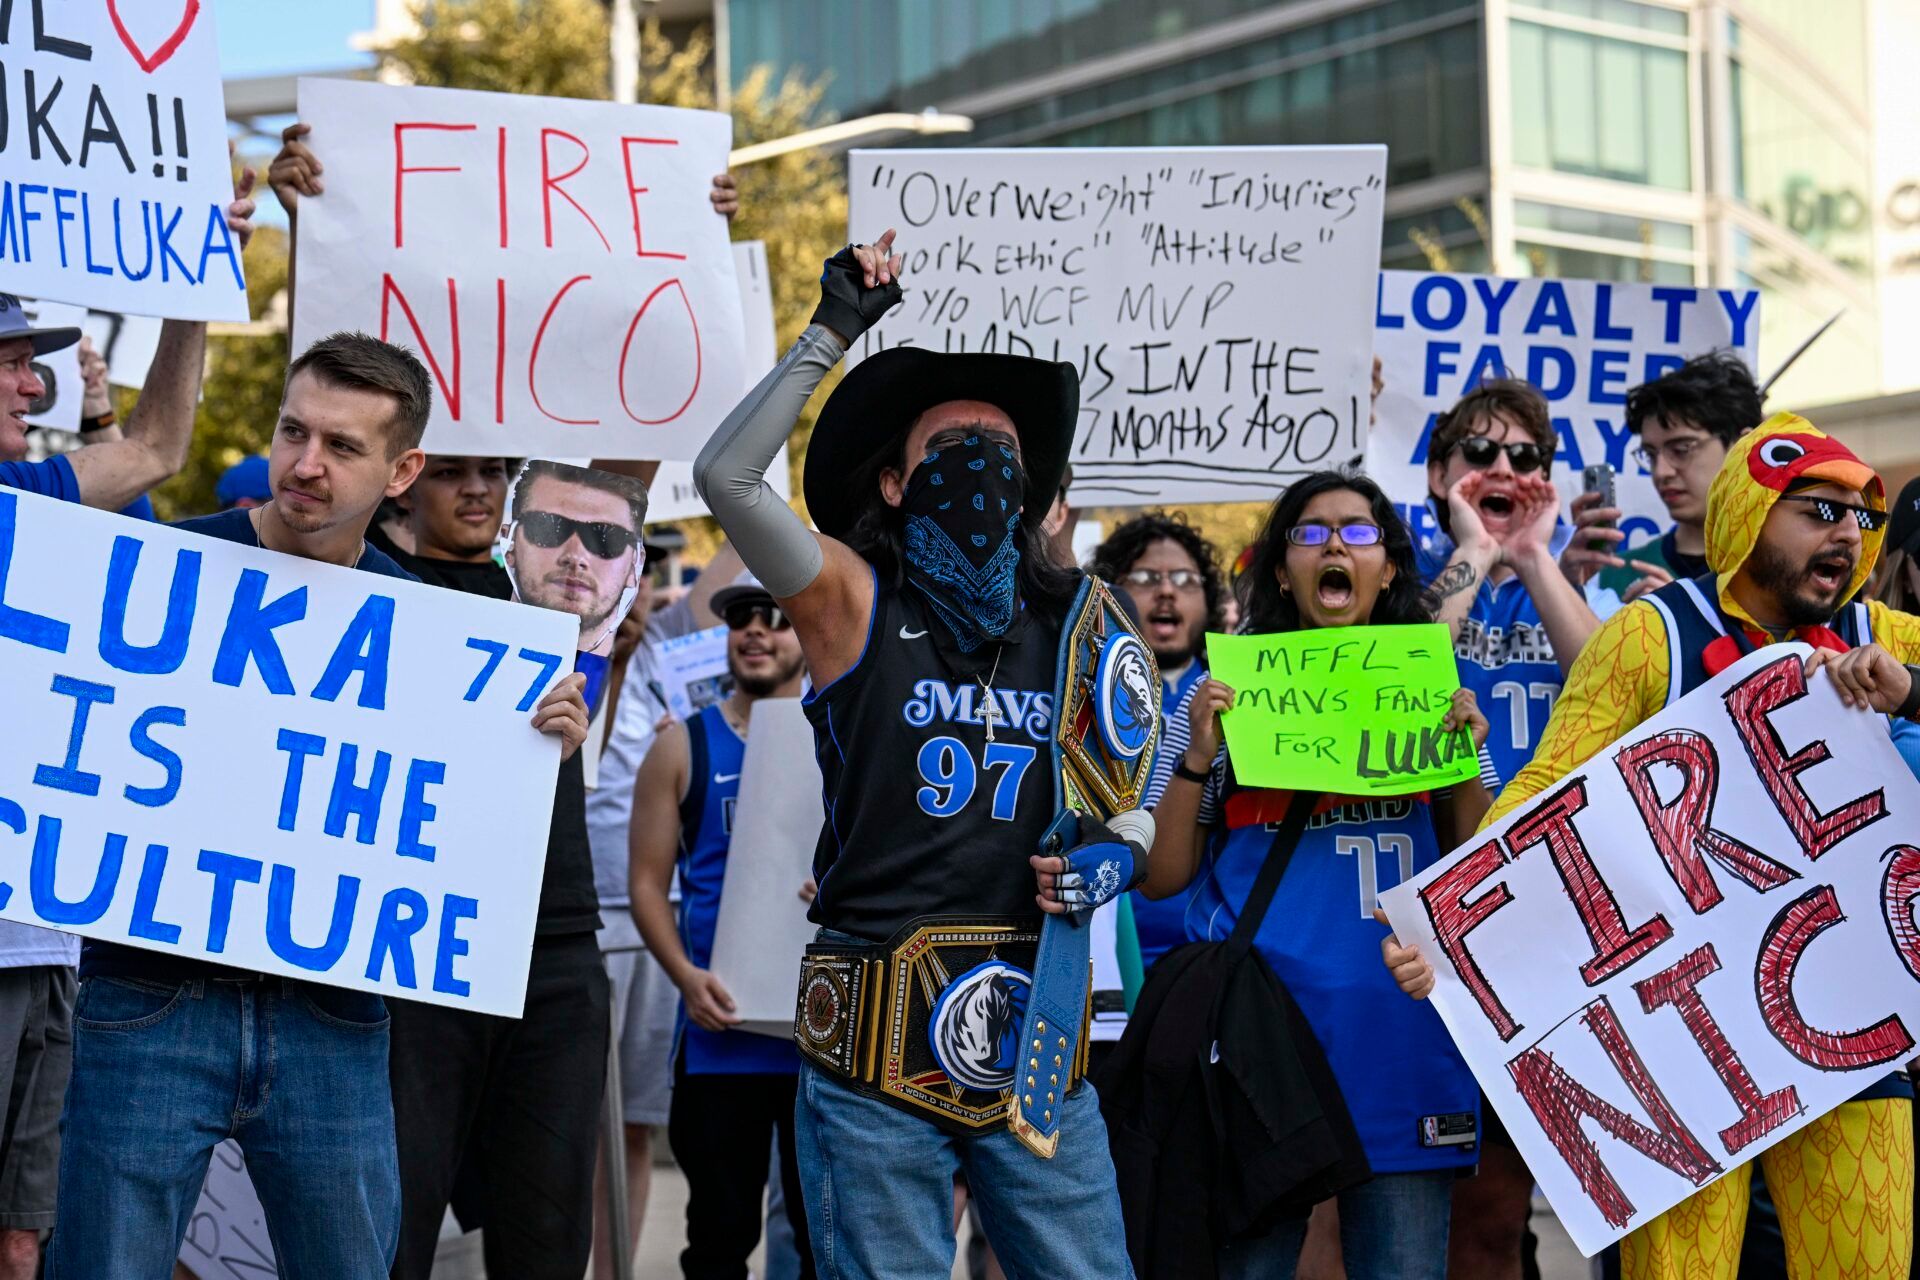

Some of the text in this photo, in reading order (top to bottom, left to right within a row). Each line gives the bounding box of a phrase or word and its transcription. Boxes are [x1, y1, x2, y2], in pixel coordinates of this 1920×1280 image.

[0, 60, 189, 182] KA!!
[394, 121, 687, 258] FIRE
[1000, 284, 1090, 329] WCF
[1117, 280, 1235, 331] MVP
[1375, 272, 1760, 347] LOYALTY
[381, 272, 702, 426] NICO
[1126, 342, 1208, 396] IN
[1214, 337, 1324, 398] THE
[0, 492, 563, 713] LUKA 77
[1256, 640, 1399, 675] MFFL
[903, 679, 1054, 742] MAVS
[1236, 685, 1449, 714] MAVS FANS
[32, 672, 447, 862] IS THE
[916, 736, 1037, 821] 97
[1356, 720, 1474, 779] LUKA
[1417, 652, 1891, 1043] FIRE
[904, 1087, 937, 1105] WORLD
[939, 1100, 1004, 1121] HEAVYWEIGHT
